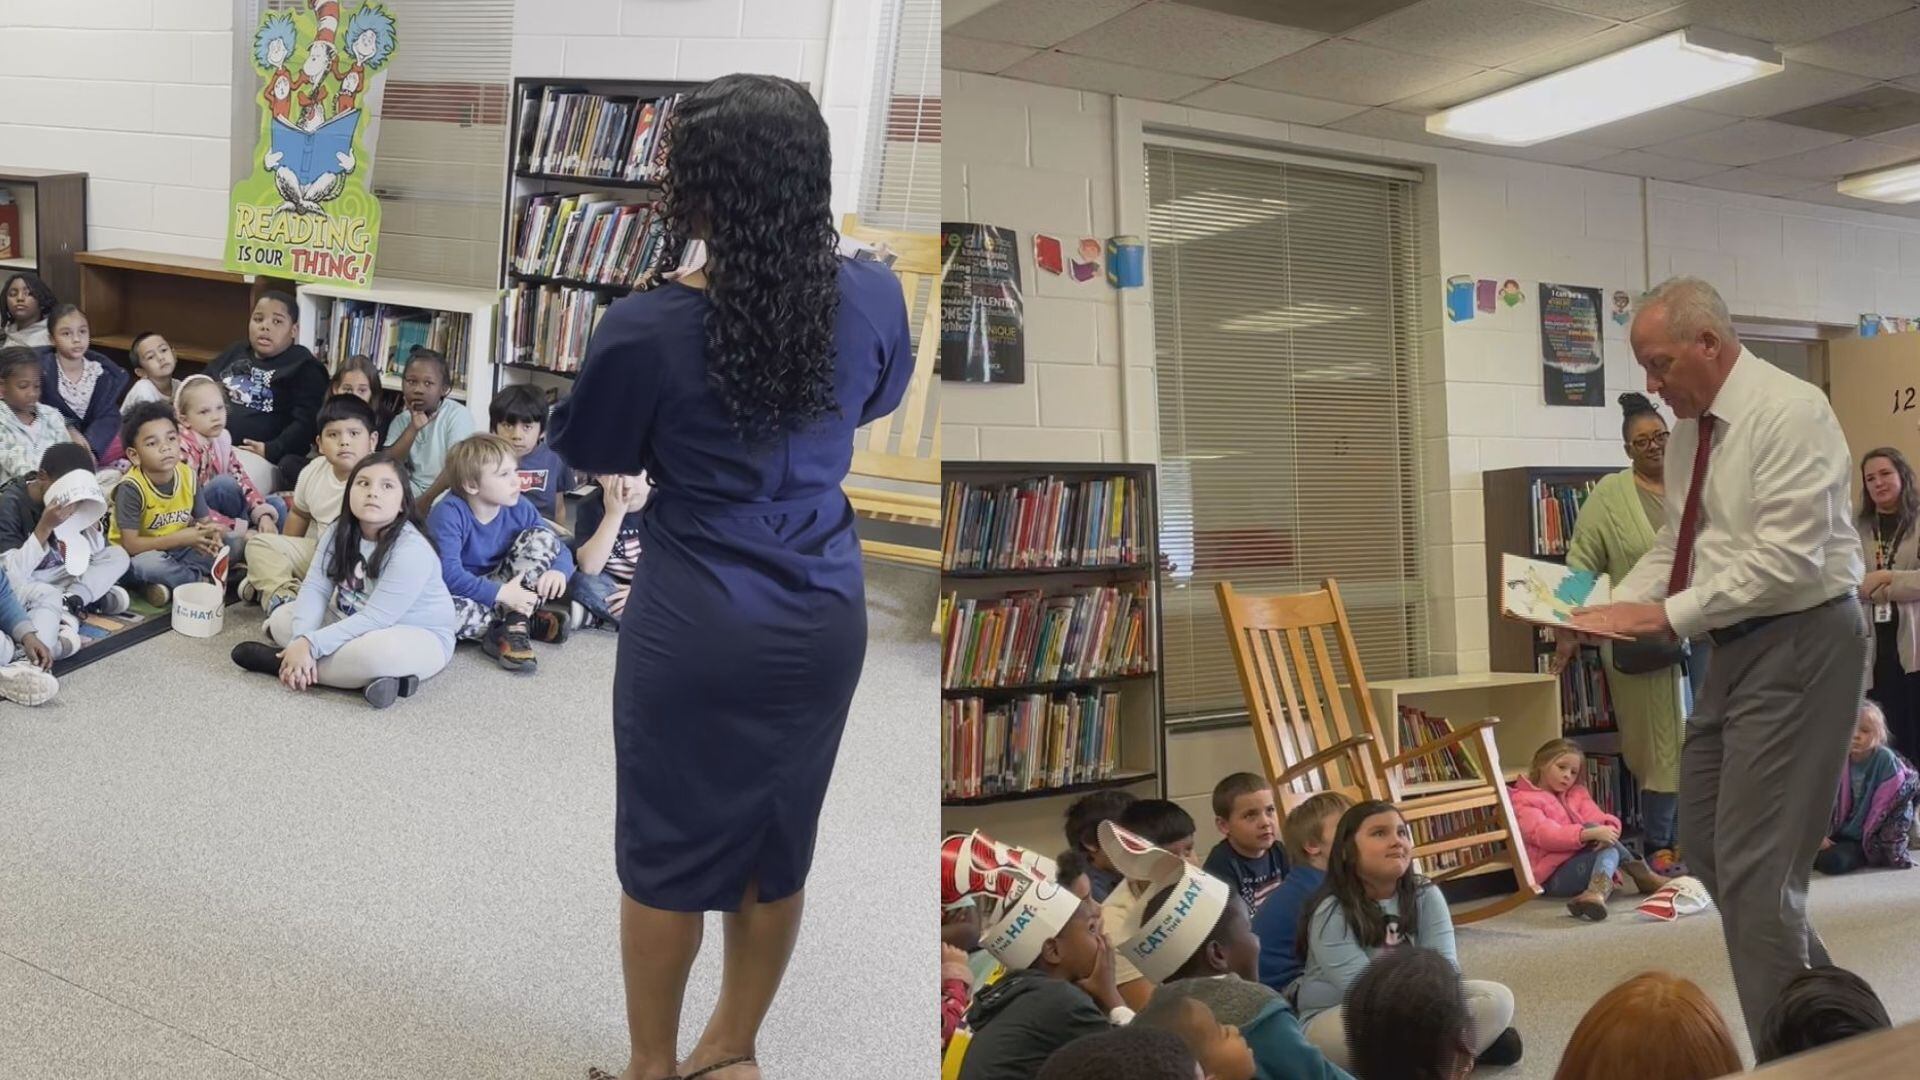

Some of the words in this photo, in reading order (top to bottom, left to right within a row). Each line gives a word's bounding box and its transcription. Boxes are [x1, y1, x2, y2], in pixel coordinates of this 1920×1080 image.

[236, 204, 370, 254] READING
[238, 245, 252, 262] IS
[255, 248, 283, 266] OUR
[291, 248, 373, 284] THING!
[1893, 387, 1916, 414] 12
[147, 510, 191, 529] LAKERS
[190, 609, 213, 620] HAT
[1005, 904, 1035, 939] HAT
[1138, 925, 1168, 955] CAT
[1174, 878, 1202, 917] HAT
